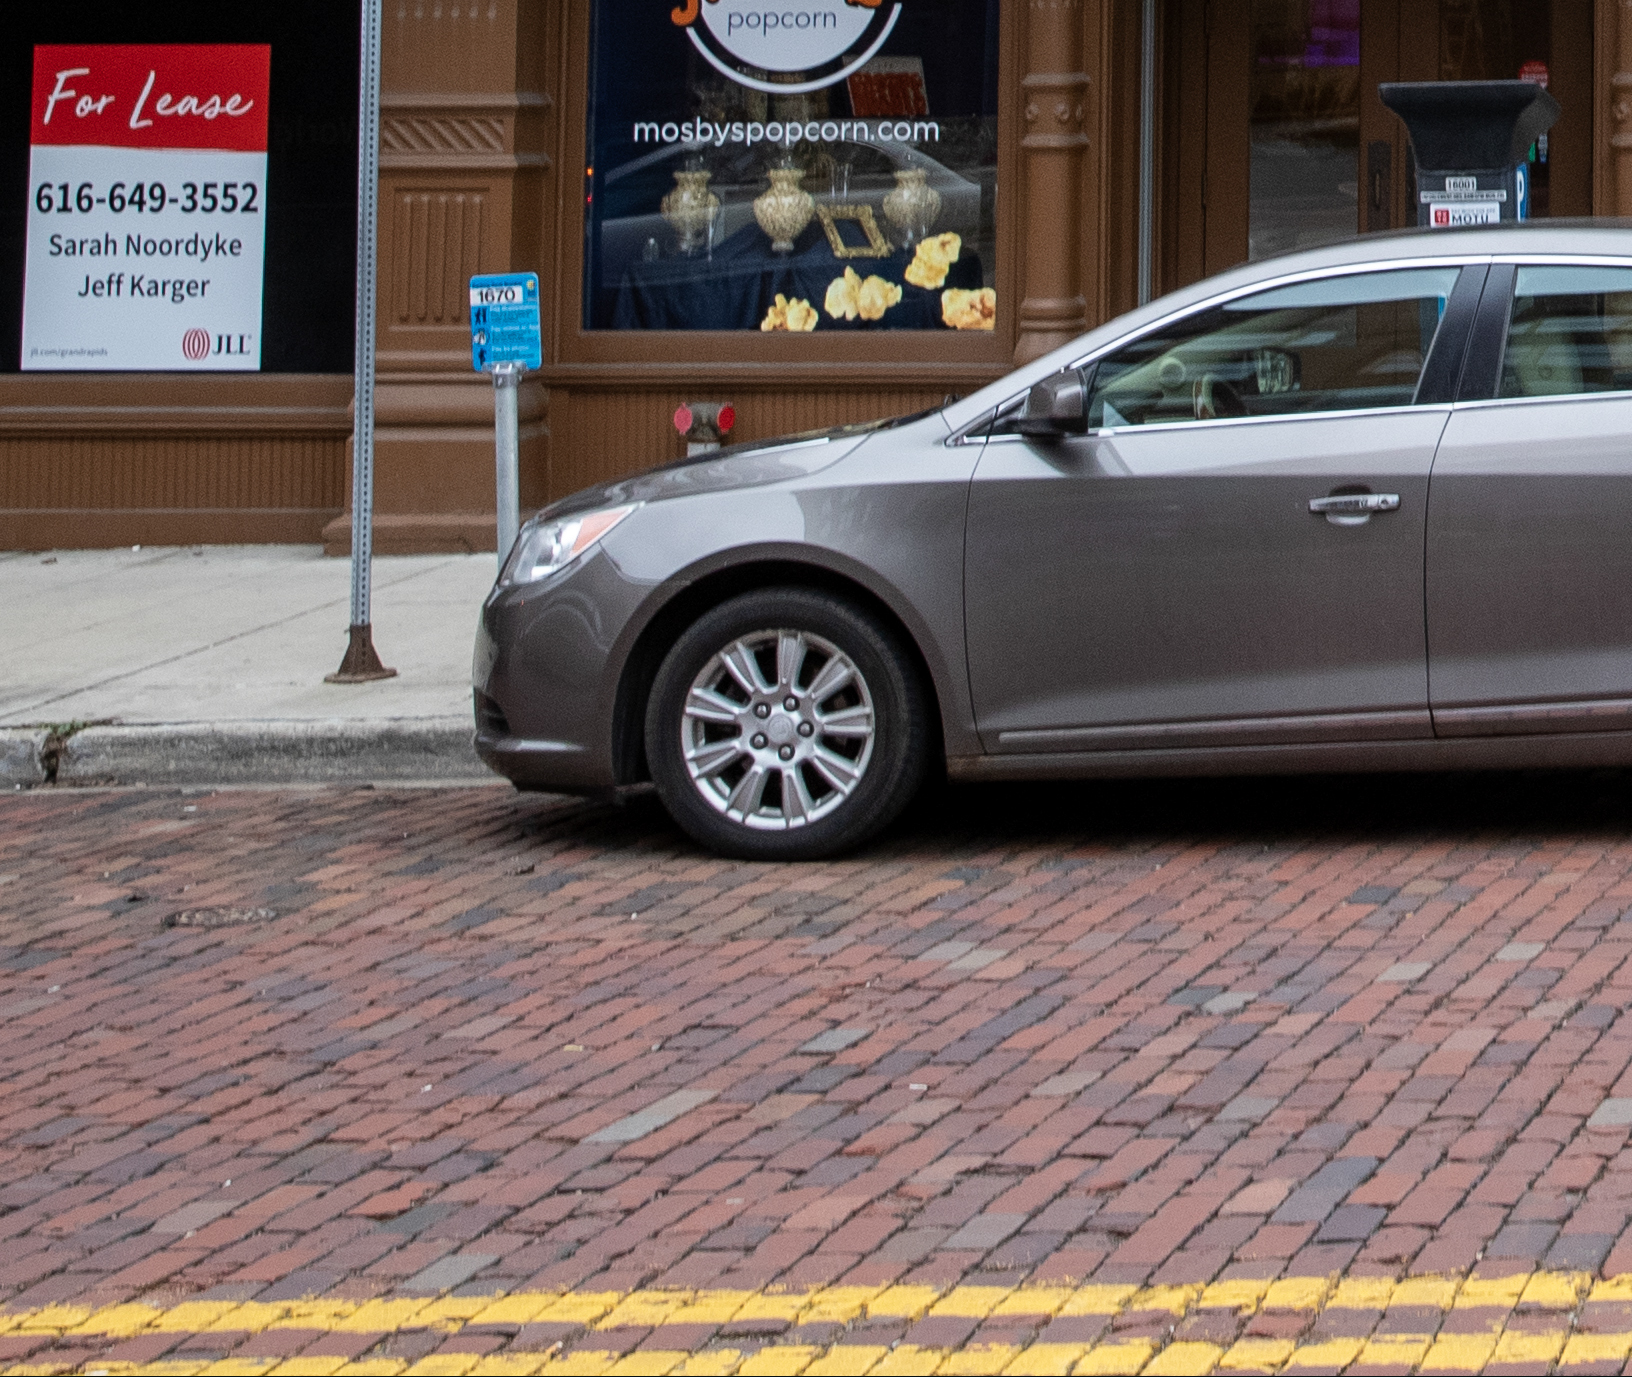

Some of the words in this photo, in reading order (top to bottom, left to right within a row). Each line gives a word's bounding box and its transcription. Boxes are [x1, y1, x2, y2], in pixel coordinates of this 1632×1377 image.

[727, 8, 838, 37] popcorn
[43, 67, 116, 125] For
[129, 69, 254, 130] Lease
[633, 116, 941, 147] mosbyspopcorn.com
[35, 182, 260, 214] 616-649-3552
[49, 233, 118, 256] Sarah
[126, 233, 243, 262] Noordyke
[78, 273, 125, 298] Jeff
[130, 274, 211, 303] Karger
[479, 287, 516, 303] 1670
[212, 334, 251, 356] JLL
